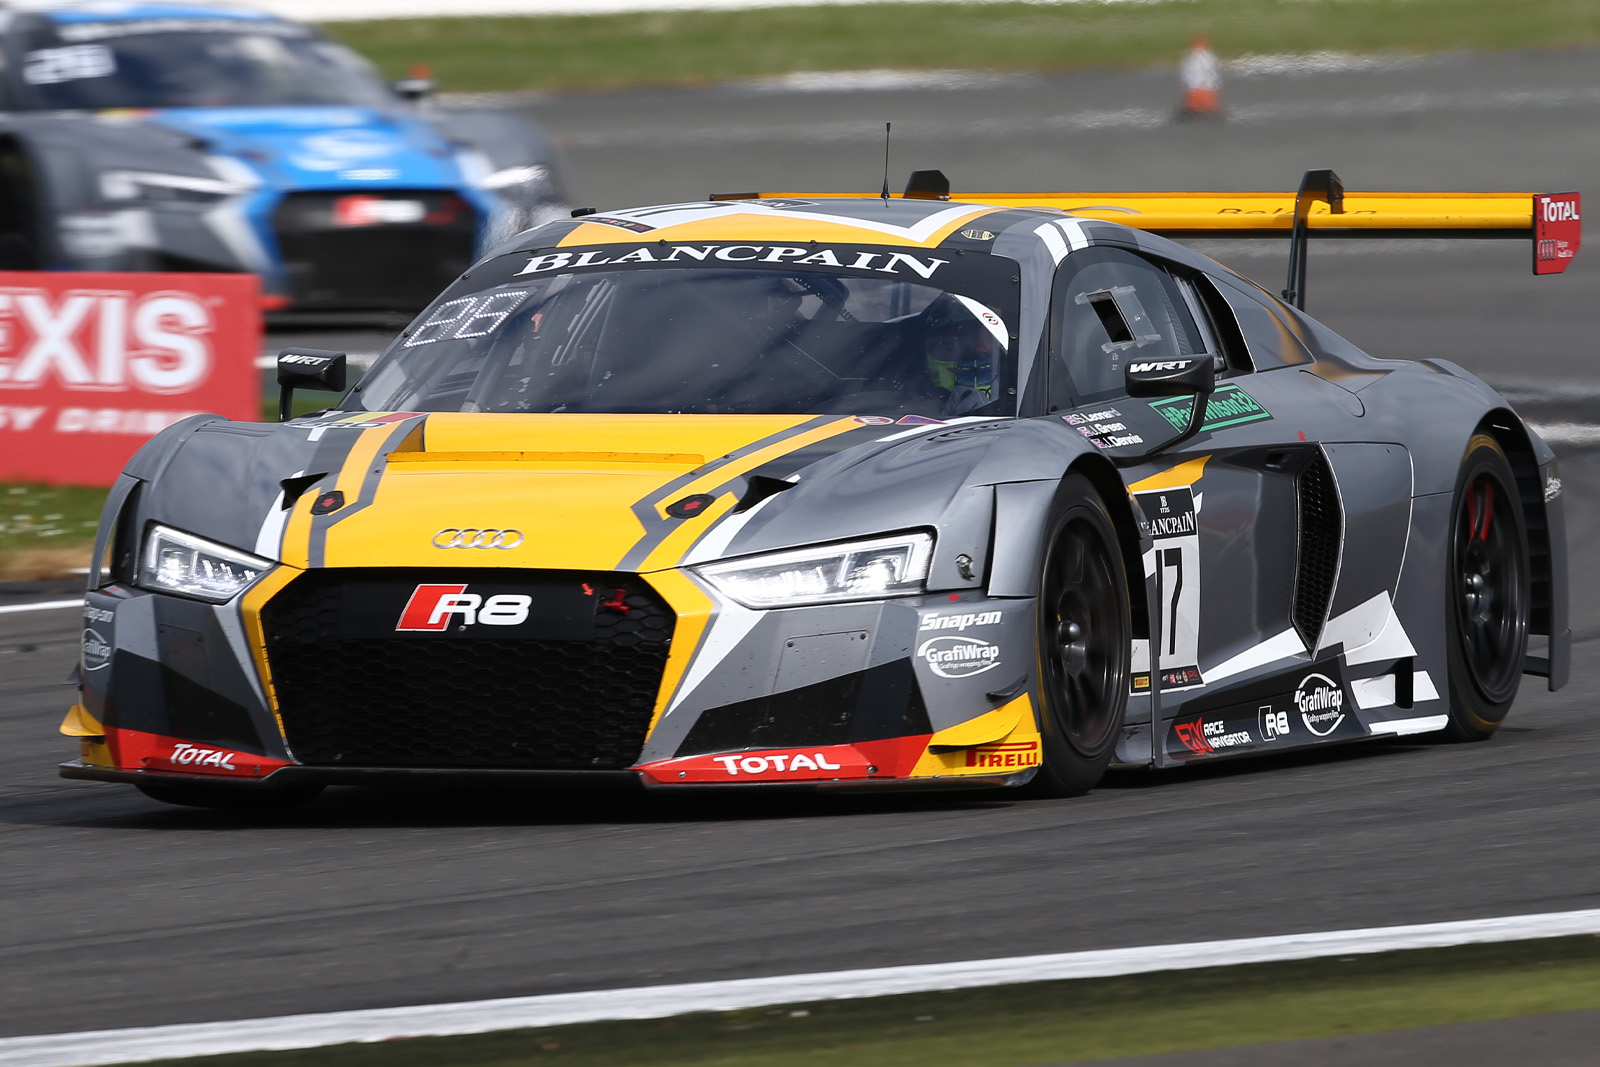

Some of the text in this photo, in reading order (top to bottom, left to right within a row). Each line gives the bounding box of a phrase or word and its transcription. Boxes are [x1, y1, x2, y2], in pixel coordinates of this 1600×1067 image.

[1541, 197, 1579, 222] TOTAL
[513, 245, 950, 279] BLANCPAIN
[278, 354, 331, 366] WRT
[1129, 360, 1192, 373] WRT
[427, 593, 532, 626] R8
[918, 611, 1003, 631] Snap-on
[926, 644, 999, 663] GrafiWrap
[1299, 686, 1343, 713] GrafiWrap
[1203, 720, 1225, 736] RACE
[1265, 711, 1291, 737] R8
[1207, 731, 1253, 749] NAVIGATOR
[169, 743, 235, 770] TOTAL
[713, 753, 841, 775] TOTAL
[965, 741, 1037, 767] PIRELLI
